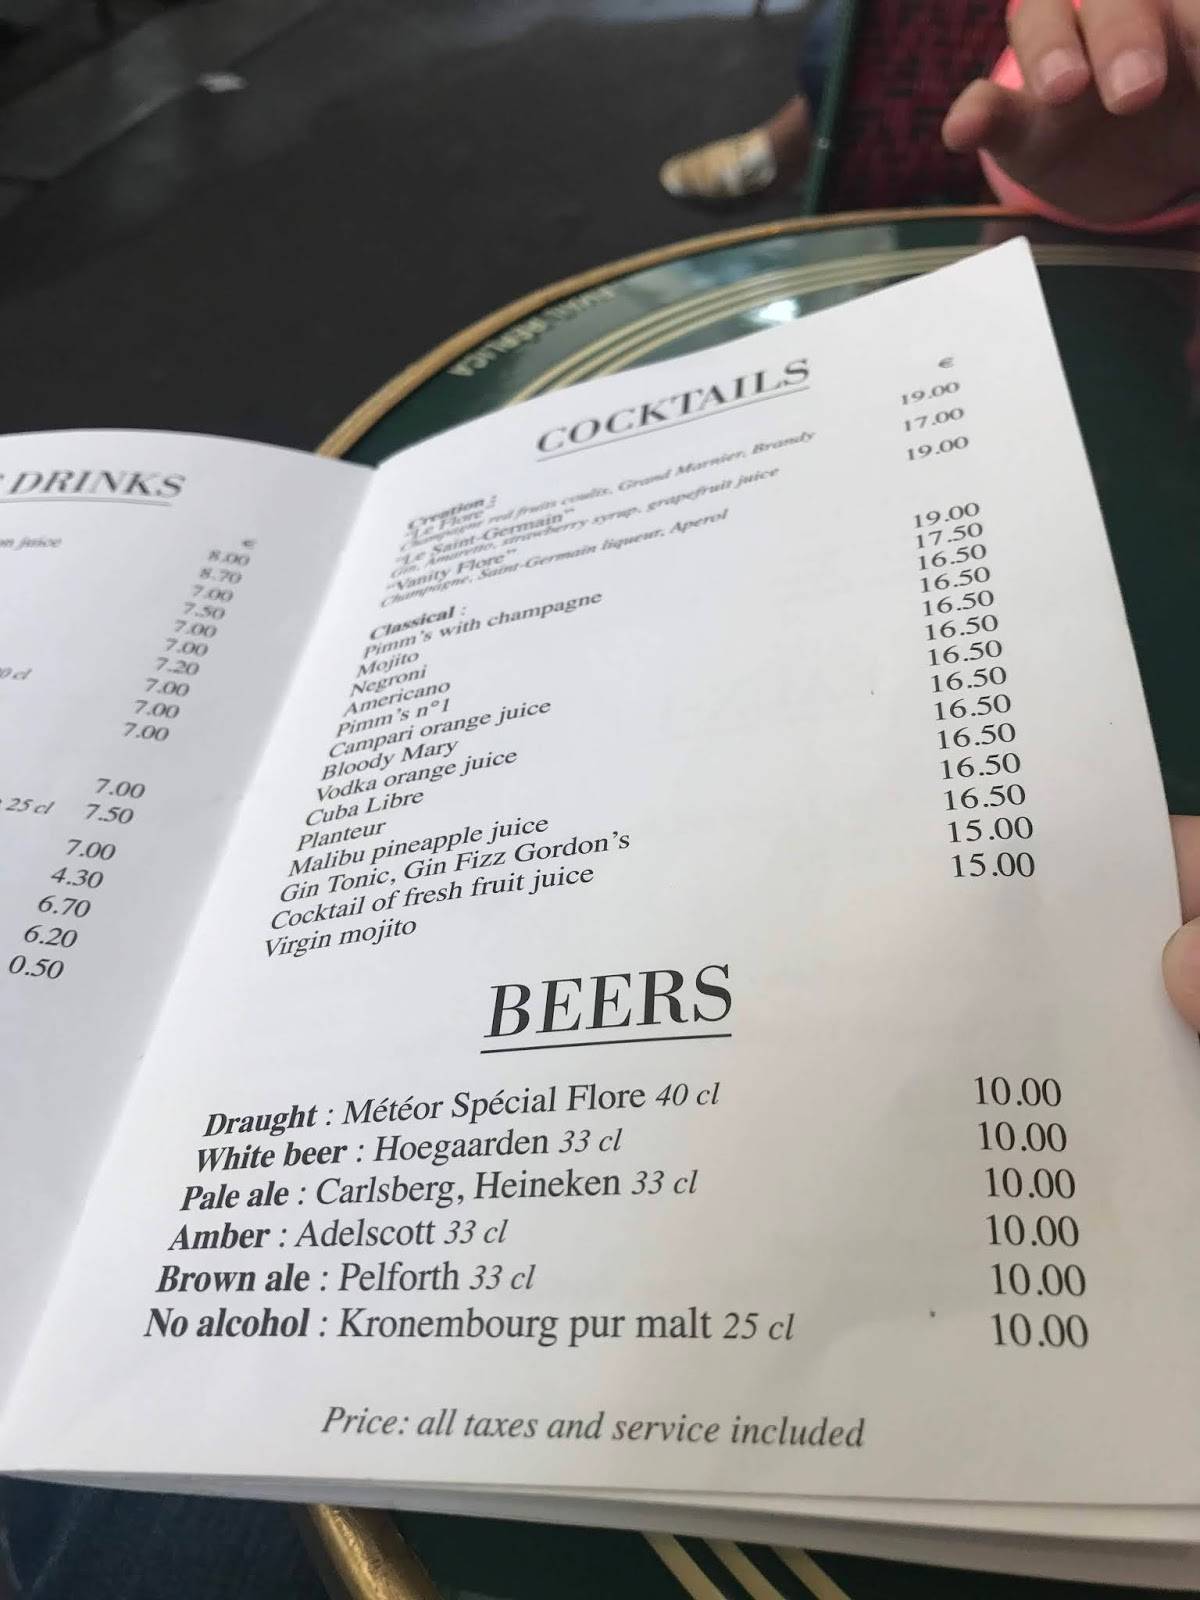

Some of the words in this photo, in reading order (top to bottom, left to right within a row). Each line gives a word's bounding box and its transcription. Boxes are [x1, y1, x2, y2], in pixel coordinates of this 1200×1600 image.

[536, 358, 810, 453] COCKTAILS
[901, 382, 961, 405] 19.00
[904, 408, 965, 432] 17.00
[618, 469, 672, 492] Grand
[751, 431, 816, 455] Brandy
[907, 436, 969, 461] 19.00
[9, 468, 187, 497] DRINKS
[647, 480, 733, 513] grapefruit
[734, 468, 780, 489] juice
[408, 497, 484, 530] Creation
[914, 502, 980, 528] 19.00
[477, 545, 596, 581] Saint-Germain
[601, 528, 665, 551] liqueur,
[669, 508, 729, 534] Aperol
[916, 522, 984, 549] 17.50
[208, 549, 250, 566] 8.00
[919, 544, 987, 571] 16.50
[199, 567, 242, 585] 8.70
[920, 566, 990, 593] 16.50
[192, 584, 233, 603] 7.00
[922, 590, 994, 616] 16.50
[184, 602, 225, 620] 7.50
[370, 605, 455, 641] Classical
[439, 618, 481, 637] with
[487, 592, 603, 627] champagne
[175, 619, 217, 638] 7.00
[925, 614, 998, 641] 16.50
[166, 638, 208, 657] 7.00
[928, 640, 1003, 666] 16.50
[156, 656, 200, 676] 7.20
[356, 652, 420, 678] Mojito
[145, 677, 190, 697] 7.00
[350, 664, 428, 697] Negroni
[931, 666, 1007, 693] 16.50
[134, 699, 180, 719] 7.00
[343, 682, 451, 718] Americano
[934, 694, 1011, 720] 16.50
[124, 722, 169, 742] 7.00
[328, 725, 414, 759] Campari
[420, 713, 491, 738] orange
[494, 700, 552, 726] juice
[336, 706, 409, 738] Pimm's
[937, 723, 1016, 749] 16.50
[320, 751, 395, 782] Bloody
[401, 740, 458, 763] Mary
[941, 753, 1021, 780] 16.50
[95, 778, 145, 799] 7.00
[317, 778, 376, 802] Vodka
[383, 763, 457, 788] orange
[460, 749, 518, 777] juice
[5, 797, 33, 812] 25
[34, 801, 55, 814] cl
[305, 803, 359, 827] Cuba
[366, 790, 425, 814] Libre
[944, 784, 1026, 811] 16.50
[85, 803, 134, 824] 7.50
[295, 820, 386, 852] Planteur
[947, 816, 1033, 843] 15.00
[66, 838, 116, 860] 7.00
[287, 851, 366, 878] Malibu
[370, 827, 483, 867] pineapple
[486, 816, 549, 846] juice
[51, 867, 104, 888] 4.30
[280, 883, 319, 903] Gin
[328, 868, 396, 896] Tonic,
[403, 860, 446, 881] Gin
[453, 849, 506, 873] Fizz
[513, 831, 631, 864] Gordon's
[951, 852, 1035, 878] 15.00
[38, 895, 91, 918] 6.70
[271, 893, 364, 931] Cocktail
[372, 886, 397, 912] of
[401, 883, 463, 909] fresh
[470, 875, 524, 898] fruit
[529, 866, 595, 895] juice
[24, 924, 78, 948] 6.20
[265, 933, 331, 958] Virgin
[339, 917, 416, 947] mojito
[8, 954, 64, 979] 0.50
[482, 964, 733, 1040] BEERS
[974, 1076, 1062, 1107] 10.00
[203, 1104, 319, 1137] Draught
[342, 1096, 444, 1125] Météor
[451, 1086, 556, 1124] Spécial
[566, 1083, 646, 1111] Flore
[655, 1083, 688, 1106] 40
[697, 1081, 720, 1105] cl
[977, 1121, 1067, 1152] 10.00
[197, 1144, 275, 1173] White
[282, 1141, 348, 1167] beer
[372, 1128, 549, 1166] Hoegaarden
[559, 1129, 591, 1153] 33
[599, 1128, 623, 1152] cl
[179, 1184, 240, 1211] Pale
[246, 1180, 289, 1207] ale
[316, 1175, 464, 1209] Carlsberg,
[473, 1168, 621, 1199] Heineken
[631, 1170, 664, 1195] 33
[673, 1169, 699, 1194] cl
[985, 1167, 1076, 1199] 10.00
[167, 1221, 271, 1251] Amber
[294, 1218, 436, 1248] Adelscott
[443, 1220, 477, 1244] 33
[483, 1219, 509, 1243] cl
[986, 1214, 1079, 1246] 10.00
[155, 1264, 256, 1292] Brown
[264, 1263, 310, 1292] ale
[337, 1261, 460, 1291] Pelforth
[469, 1264, 503, 1290] 33
[510, 1264, 537, 1290] cl
[991, 1263, 1086, 1296] 10.00
[143, 1307, 188, 1338] No
[196, 1307, 311, 1338] alcohol
[336, 1307, 559, 1348] Kronembourg
[567, 1314, 626, 1347] pur
[636, 1306, 713, 1339] malt
[722, 1312, 759, 1340] 25
[768, 1313, 796, 1341] cl
[990, 1313, 1088, 1347] 10.00
[321, 1406, 411, 1436] Price:
[418, 1408, 457, 1437] all
[463, 1411, 539, 1438] taxes
[547, 1410, 604, 1440] and
[611, 1412, 719, 1443] service
[729, 1415, 867, 1449] included
